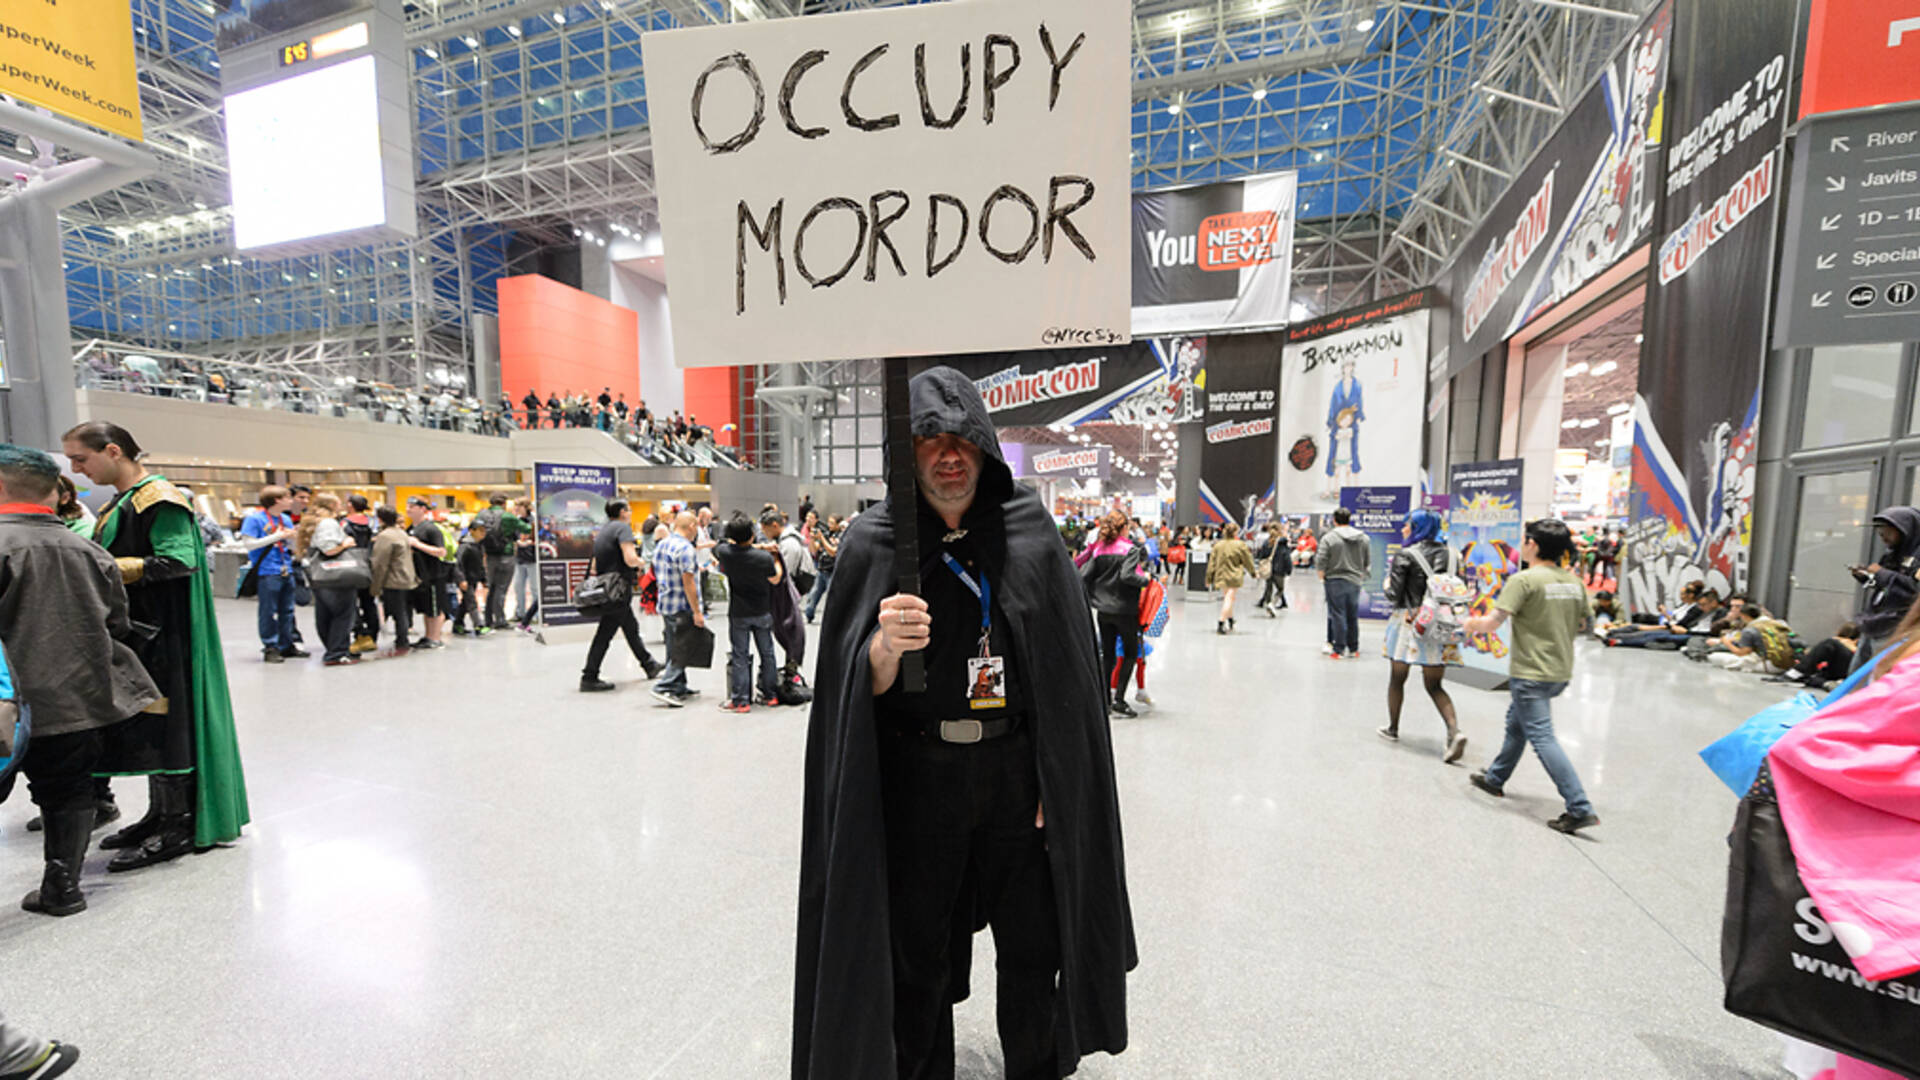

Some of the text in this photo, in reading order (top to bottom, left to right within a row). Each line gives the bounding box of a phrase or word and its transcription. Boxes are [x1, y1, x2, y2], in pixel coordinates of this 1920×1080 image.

[691, 20, 1087, 155] OCCUPY
[1669, 54, 1785, 172] WELCOME TO
[1667, 89, 1784, 197] THE ONE & ONLY
[1867, 131, 1917, 147] River
[1861, 170, 1918, 188] Javits
[1208, 219, 1232, 229] TAKE
[1512, 181, 1550, 271] CON
[1662, 158, 1770, 280] COMIC CON
[1857, 210, 1883, 226] 1D
[736, 175, 1096, 315] MORDOR
[1207, 224, 1273, 248] NEXT
[1146, 230, 1197, 268] You
[1207, 243, 1282, 266] LEVEL
[1049, 361, 1097, 396] CON
[1209, 390, 1275, 402] WELCOME TO
[1252, 401, 1275, 410] ONLY
[1109, 396, 1178, 425] NYCC
[1208, 423, 1245, 441] COMIC
[1247, 420, 1272, 435] CON
[551, 467, 600, 477] STEP INTO
[1079, 466, 1099, 476] LIVE
